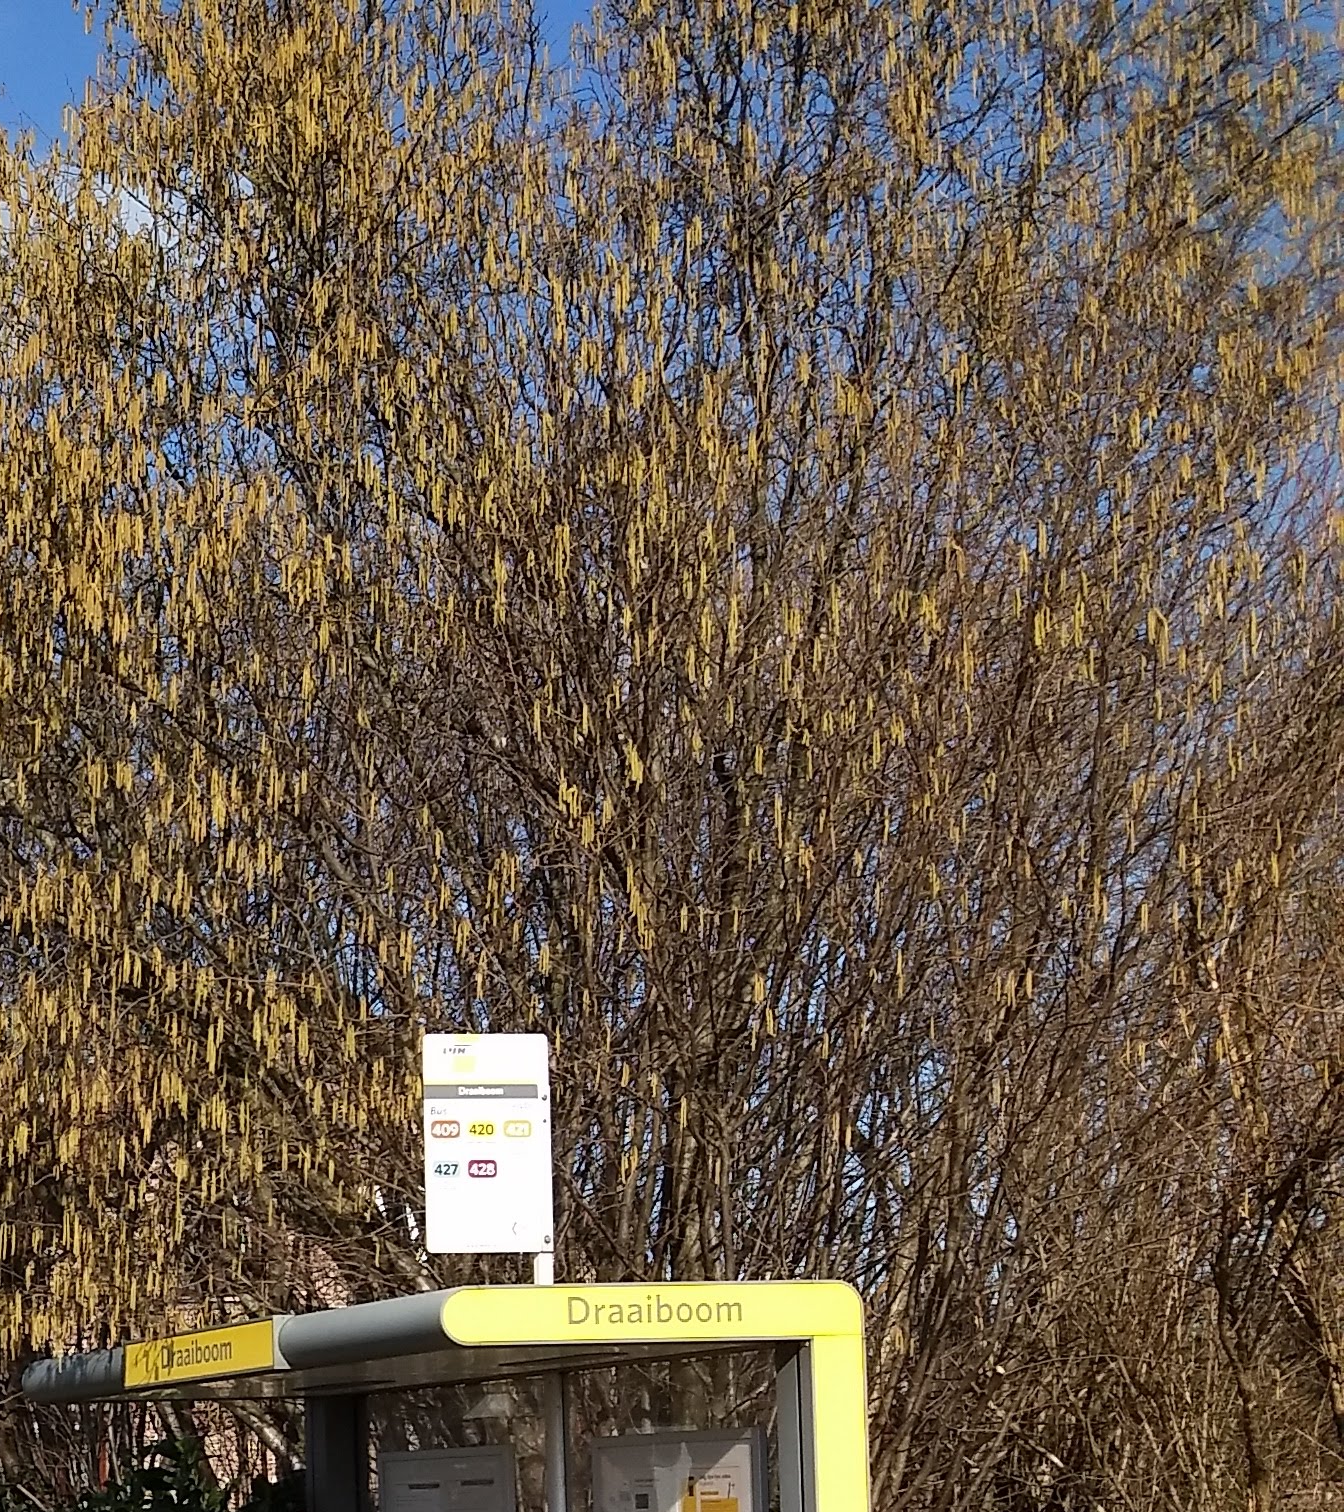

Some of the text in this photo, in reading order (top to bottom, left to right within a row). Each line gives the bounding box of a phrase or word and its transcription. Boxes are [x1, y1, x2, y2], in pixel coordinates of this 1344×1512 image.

[432, 1123, 459, 1137] 409
[469, 1124, 494, 1135] 420
[434, 1163, 496, 1176] 427 428
[568, 1294, 743, 1325] Draaiboom
[162, 1338, 232, 1369] Draaiboom
